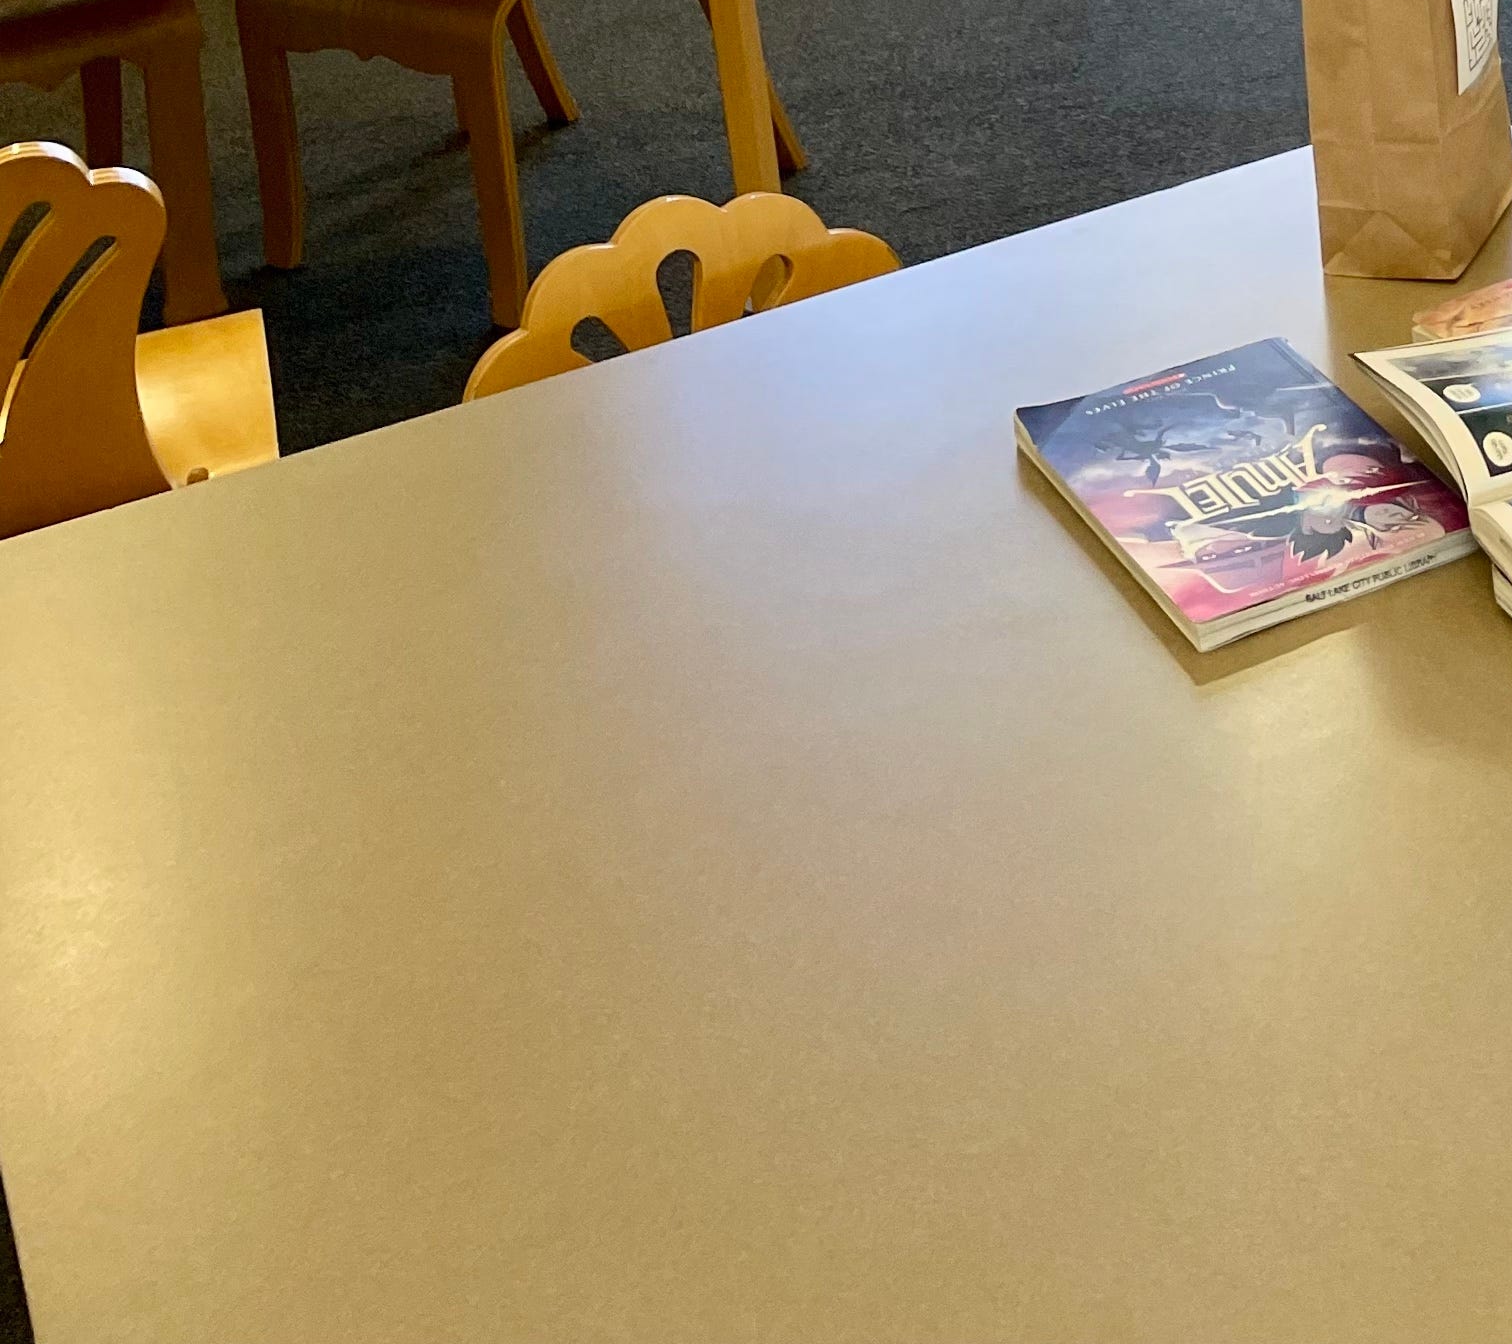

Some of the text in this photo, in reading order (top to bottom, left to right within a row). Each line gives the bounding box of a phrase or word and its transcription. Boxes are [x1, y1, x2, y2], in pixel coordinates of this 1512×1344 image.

[1132, 387, 1159, 403] THE
[1164, 380, 1184, 393] OF
[1124, 424, 1327, 528] AMULET
[1352, 574, 1371, 591] CITY
[1372, 565, 1402, 587] PUBLIC
